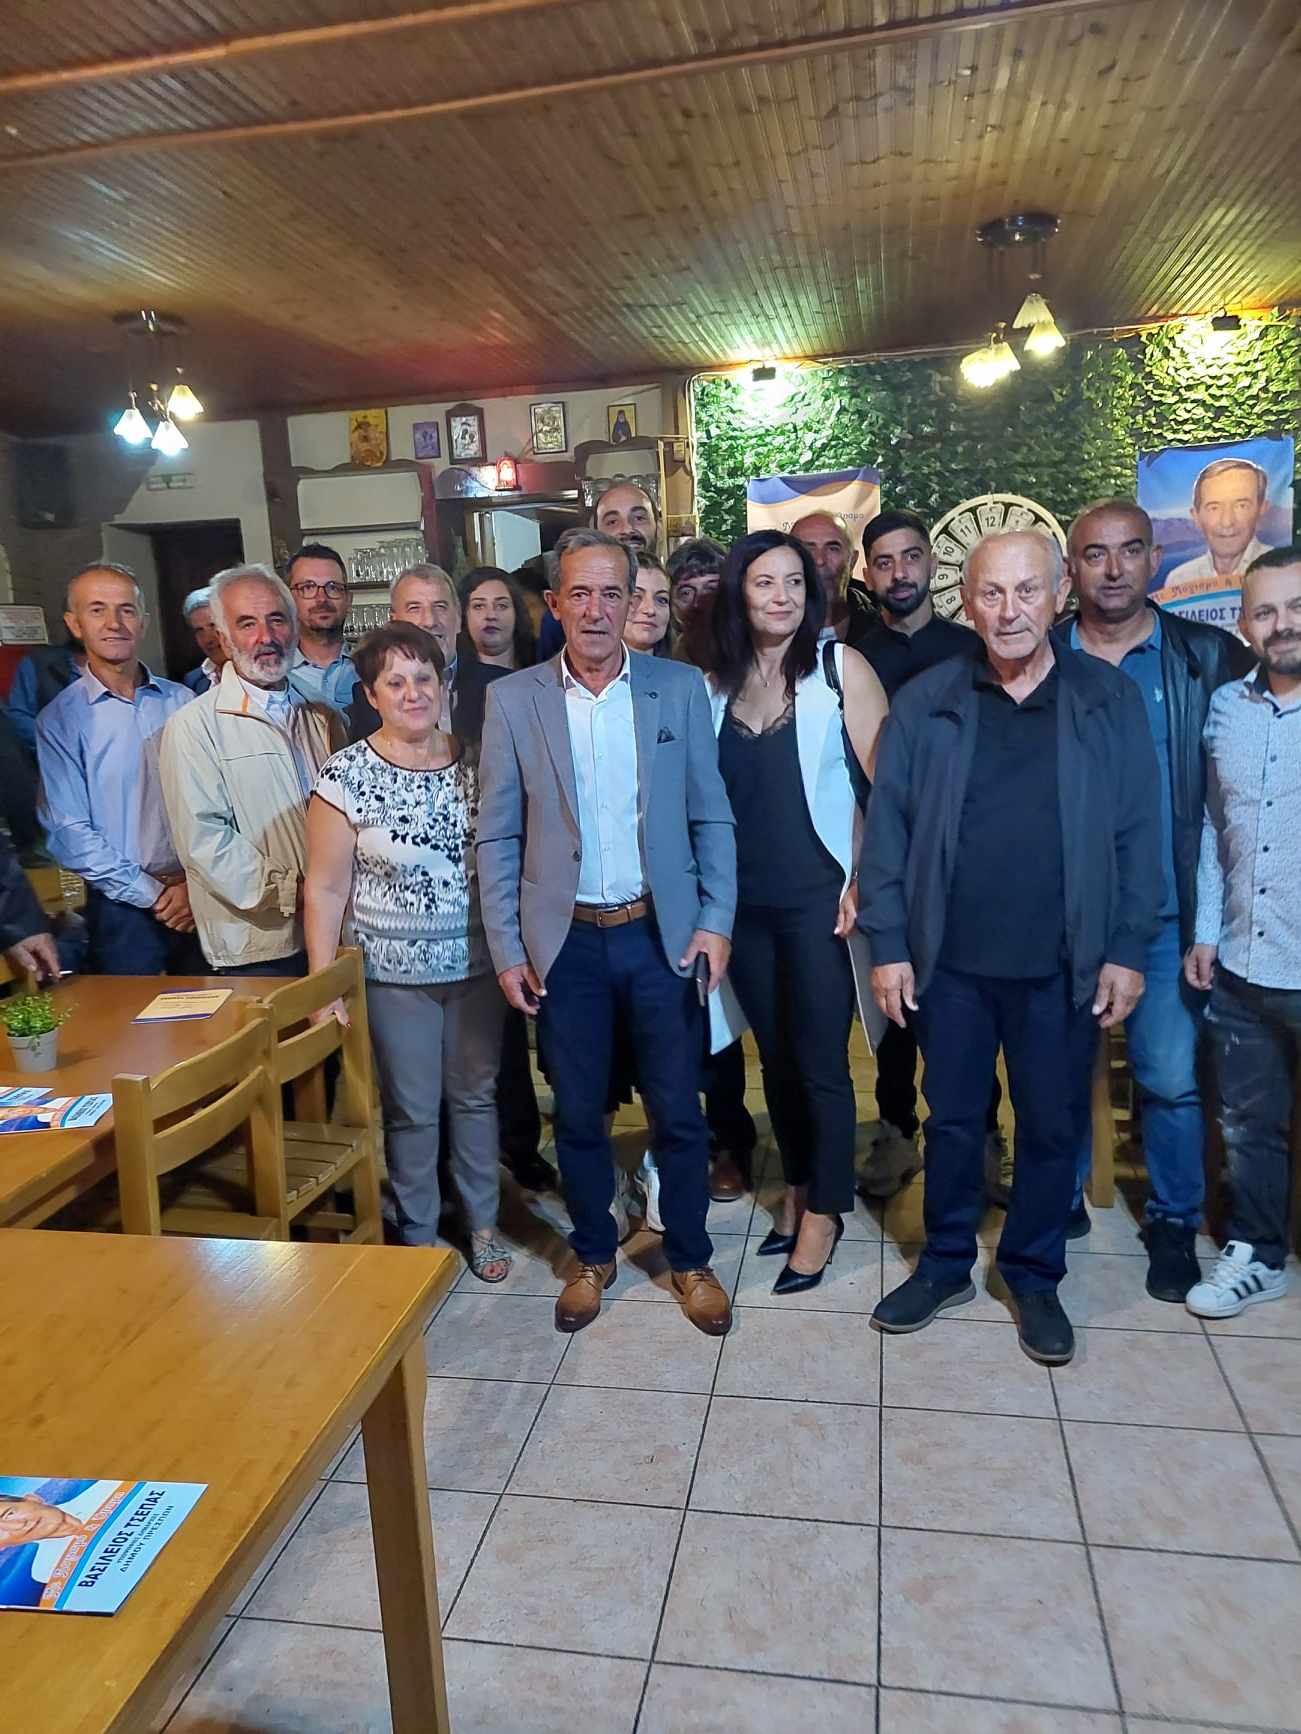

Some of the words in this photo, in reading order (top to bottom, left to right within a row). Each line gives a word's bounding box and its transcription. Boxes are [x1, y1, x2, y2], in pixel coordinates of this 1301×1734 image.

[985, 516, 996, 528] 12
[960, 525, 972, 537] 11
[942, 546, 955, 557] 10
[945, 595, 956, 604] 8
[1178, 607, 1226, 622] ΣΙΛΕΙΟΣ
[77, 1531, 134, 1587] ΒΑΣΙΛΕΙΟΣ
[123, 1490, 166, 1528] ΤΣΕΠΑΣ
[120, 1542, 145, 1572] ΔΗΜΟΥ
